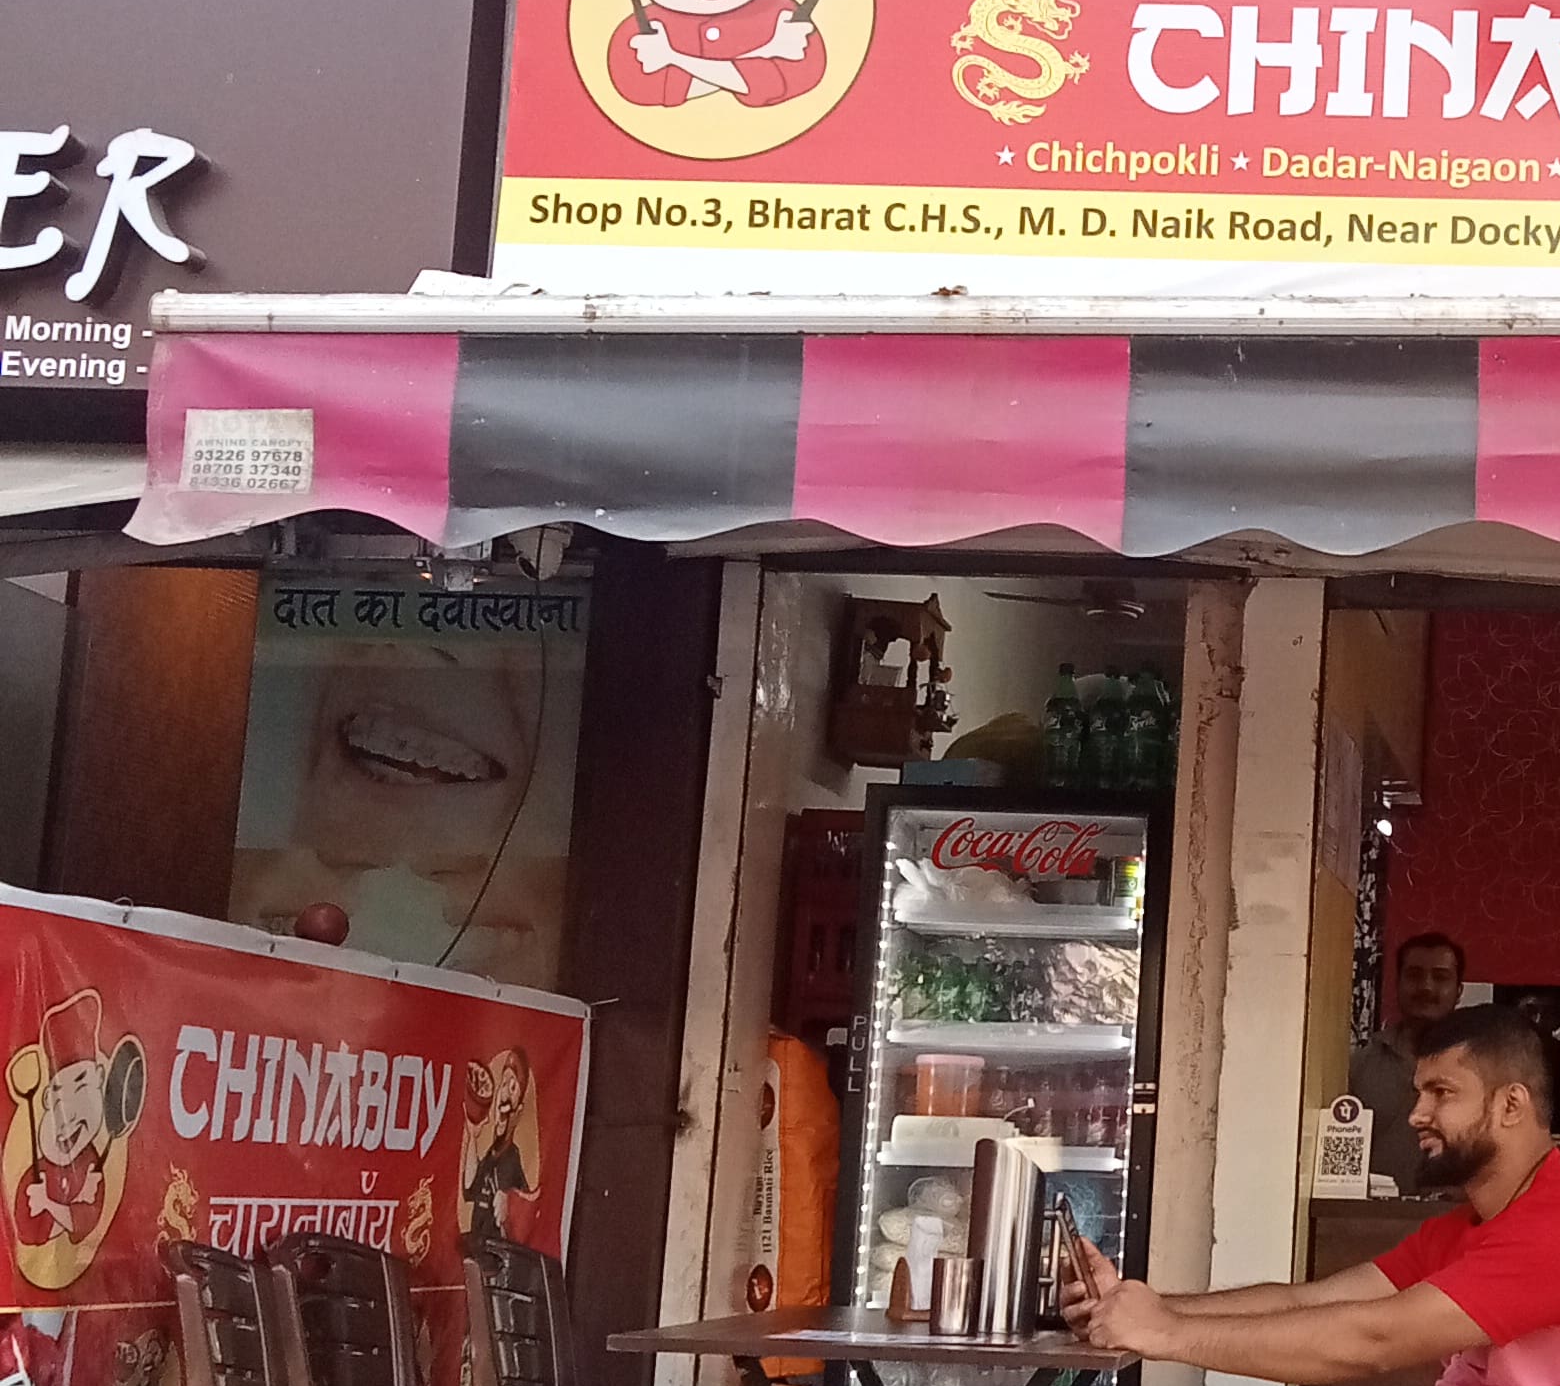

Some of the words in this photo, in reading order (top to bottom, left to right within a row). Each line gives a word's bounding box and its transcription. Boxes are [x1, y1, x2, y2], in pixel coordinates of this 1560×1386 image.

[1026, 139, 1220, 181] Chichpokli
[1261, 146, 1541, 189] Dadar-Naigaon
[529, 193, 622, 231] Shop
[635, 196, 734, 234] No.3,
[748, 197, 871, 232] Bharat
[884, 201, 1004, 241] C.H.S.,
[1018, 206, 1067, 236] M.
[1081, 207, 1118, 238] D.
[1132, 208, 1216, 241] Naik
[1228, 210, 1334, 248] Road,
[1348, 213, 1438, 245] Near
[4, 315, 132, 350] Morning
[0, 350, 126, 385] Evening
[192, 464, 243, 474] 98705
[249, 465, 301, 476] 37340
[194, 450, 245, 461] 93226
[251, 451, 302, 462] 97678
[247, 478, 299, 489] 02667
[353, 589, 406, 627] का
[931, 817, 1110, 877] Coca-Cola
[847, 1015, 867, 1093] PULL
[169, 1024, 452, 1160] CHINABOY
[1327, 1125, 1362, 1133] PhonePe
[763, 1148, 774, 1173] Rice
[763, 1176, 774, 1224] Basmati
